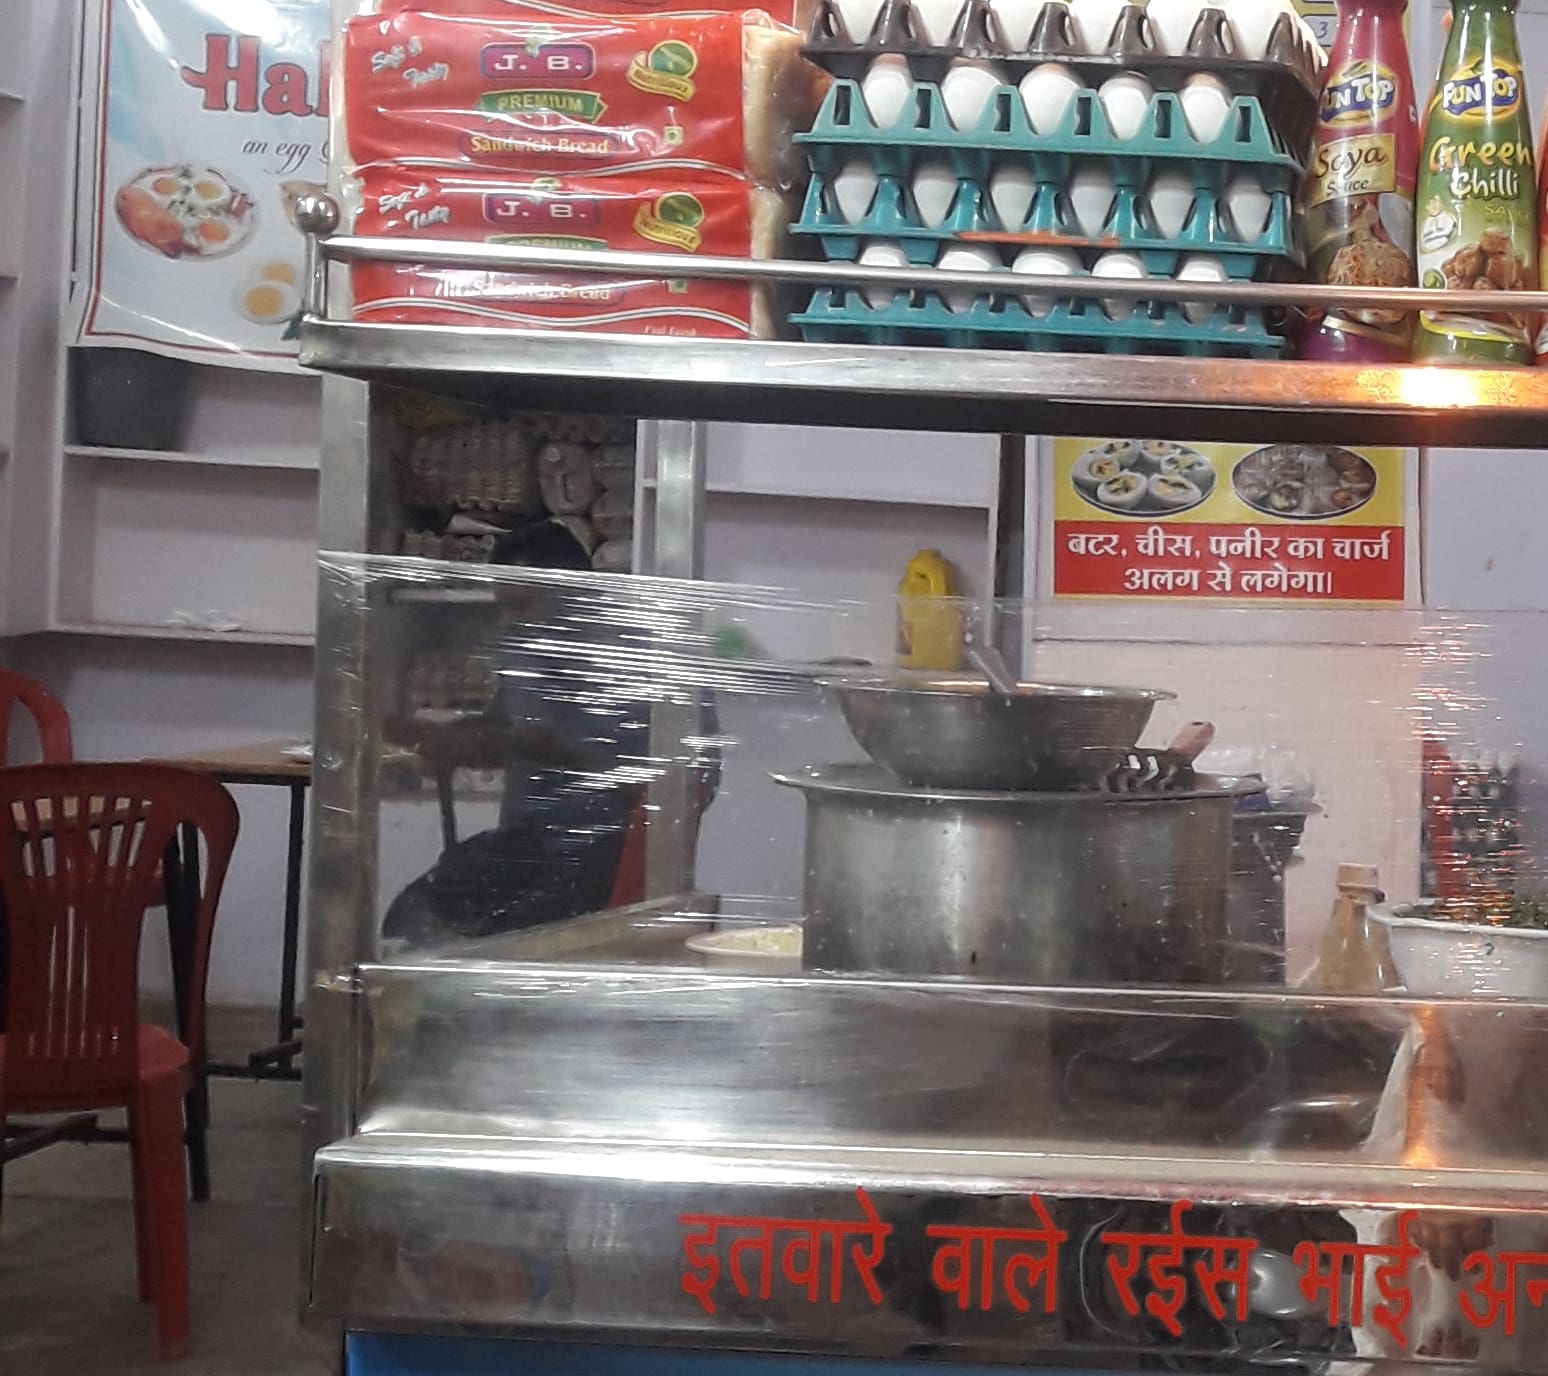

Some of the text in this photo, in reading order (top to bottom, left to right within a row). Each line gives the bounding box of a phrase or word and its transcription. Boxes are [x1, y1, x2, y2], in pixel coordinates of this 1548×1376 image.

[497, 94, 584, 113] PREMIUM
[242, 140, 312, 175] an egg
[470, 135, 610, 156] Sandwich Bread
[1429, 136, 1532, 176] Green
[1316, 147, 1387, 179] Soya
[1450, 167, 1519, 197] Chilli
[1208, 527, 1281, 560] पनीर
[1287, 536, 1325, 560] का
[1332, 529, 1392, 561] चार्ज
[1123, 567, 1202, 591] अलग
[1206, 561, 1234, 592] से
[679, 1186, 892, 1314] इतवारे
[926, 1193, 1068, 1314] वाले
[1100, 1199, 1260, 1337] रईस
[1292, 1210, 1421, 1346] भाई
